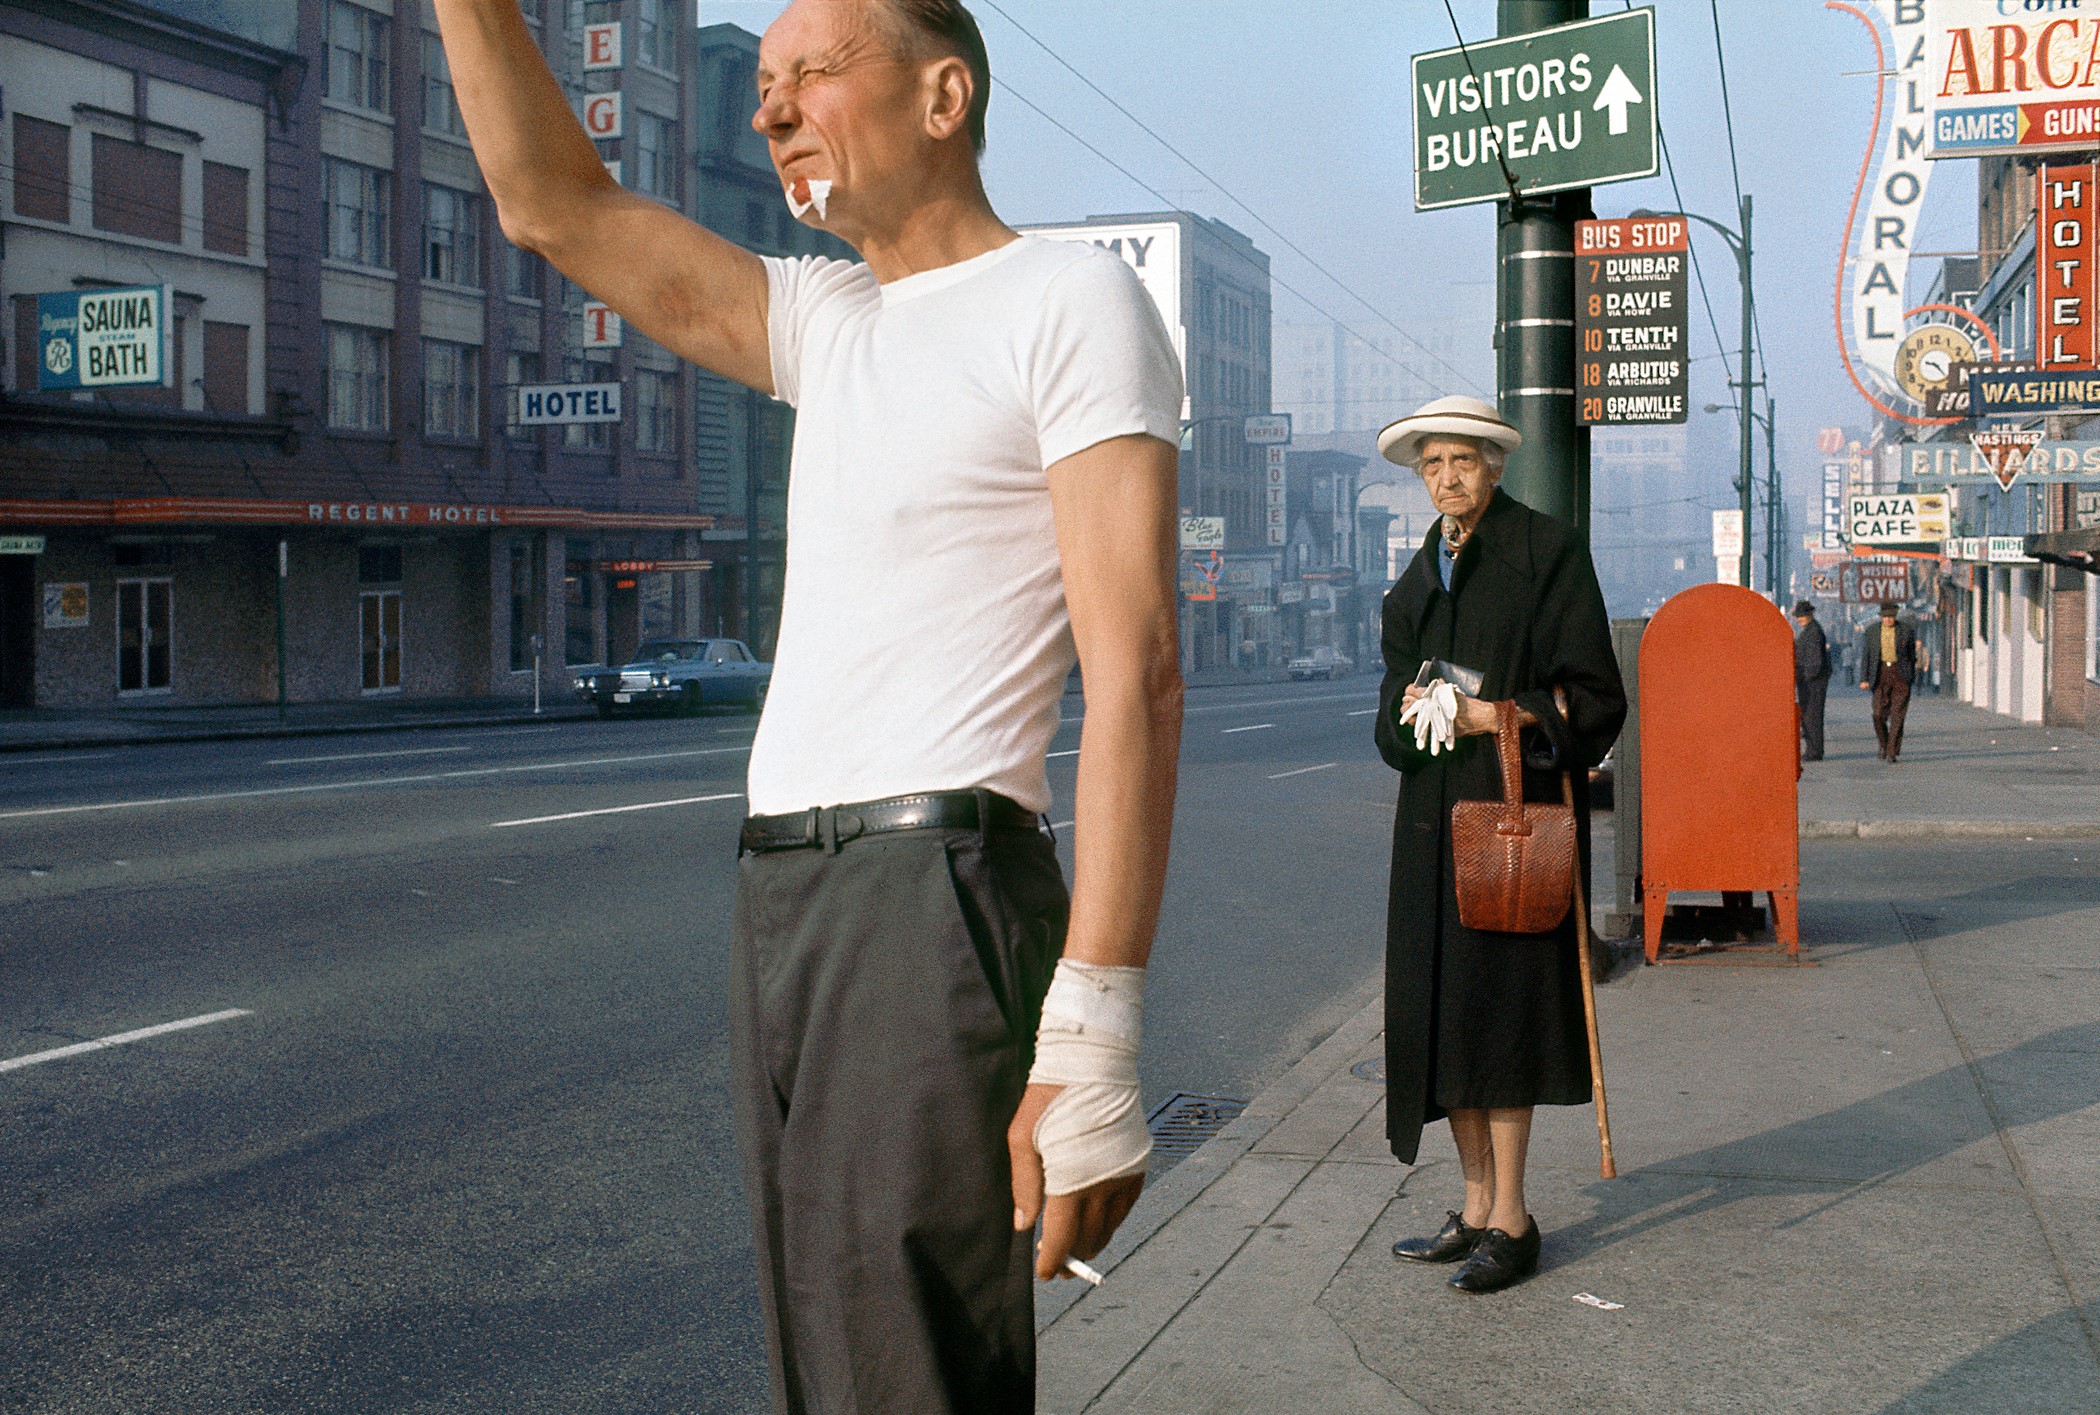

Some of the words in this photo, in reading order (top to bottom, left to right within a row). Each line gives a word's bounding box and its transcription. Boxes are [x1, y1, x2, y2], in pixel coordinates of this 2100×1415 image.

[1423, 53, 1592, 118] VISITORS
[1937, 112, 2015, 142] GAMES
[1428, 110, 1582, 172] BUREAU
[1582, 225, 1620, 250] BUS
[1632, 222, 1681, 247] STOP
[1589, 260, 1600, 283] 7
[1606, 257, 1680, 276] DUNBAR
[1625, 273, 1671, 282] GRANVILLE
[2053, 180, 2082, 363] HOTEL
[83, 297, 152, 332] SAUNA
[1588, 294, 1601, 317] 8
[1606, 291, 1672, 310] DAVIE
[1607, 309, 1621, 317] VIA
[1625, 308, 1652, 316] HOWE
[1584, 328, 1602, 352] 10
[1607, 326, 1678, 344] TENTH
[1607, 344, 1621, 352] VIA
[1625, 343, 1672, 351] GRANVILLE
[89, 343, 148, 377] BATH
[1583, 363, 1601, 386] 18
[1607, 361, 1680, 379] ARBUTUS
[1607, 378, 1621, 386] VIA
[1624, 378, 1671, 386] RICHARDS
[1981, 380, 2100, 403] WASHING
[527, 391, 615, 418] HOTEL
[1583, 398, 1602, 421] 20
[1607, 396, 1682, 413] GRANVILLE
[1608, 413, 1621, 421] VIA
[1625, 412, 1672, 421] GRANVILLE
[1975, 433, 2041, 447] HASTINGS
[1911, 446, 2100, 476] BILLIARDS
[1270, 448, 1281, 543] HOTEL
[1853, 500, 1914, 516] PLAZA
[308, 504, 409, 521] REGENT
[429, 506, 500, 523] HOTEL
[1853, 520, 1917, 536] CAFE
[613, 561, 653, 572] LOBBY
[1861, 578, 1905, 599] GYM
